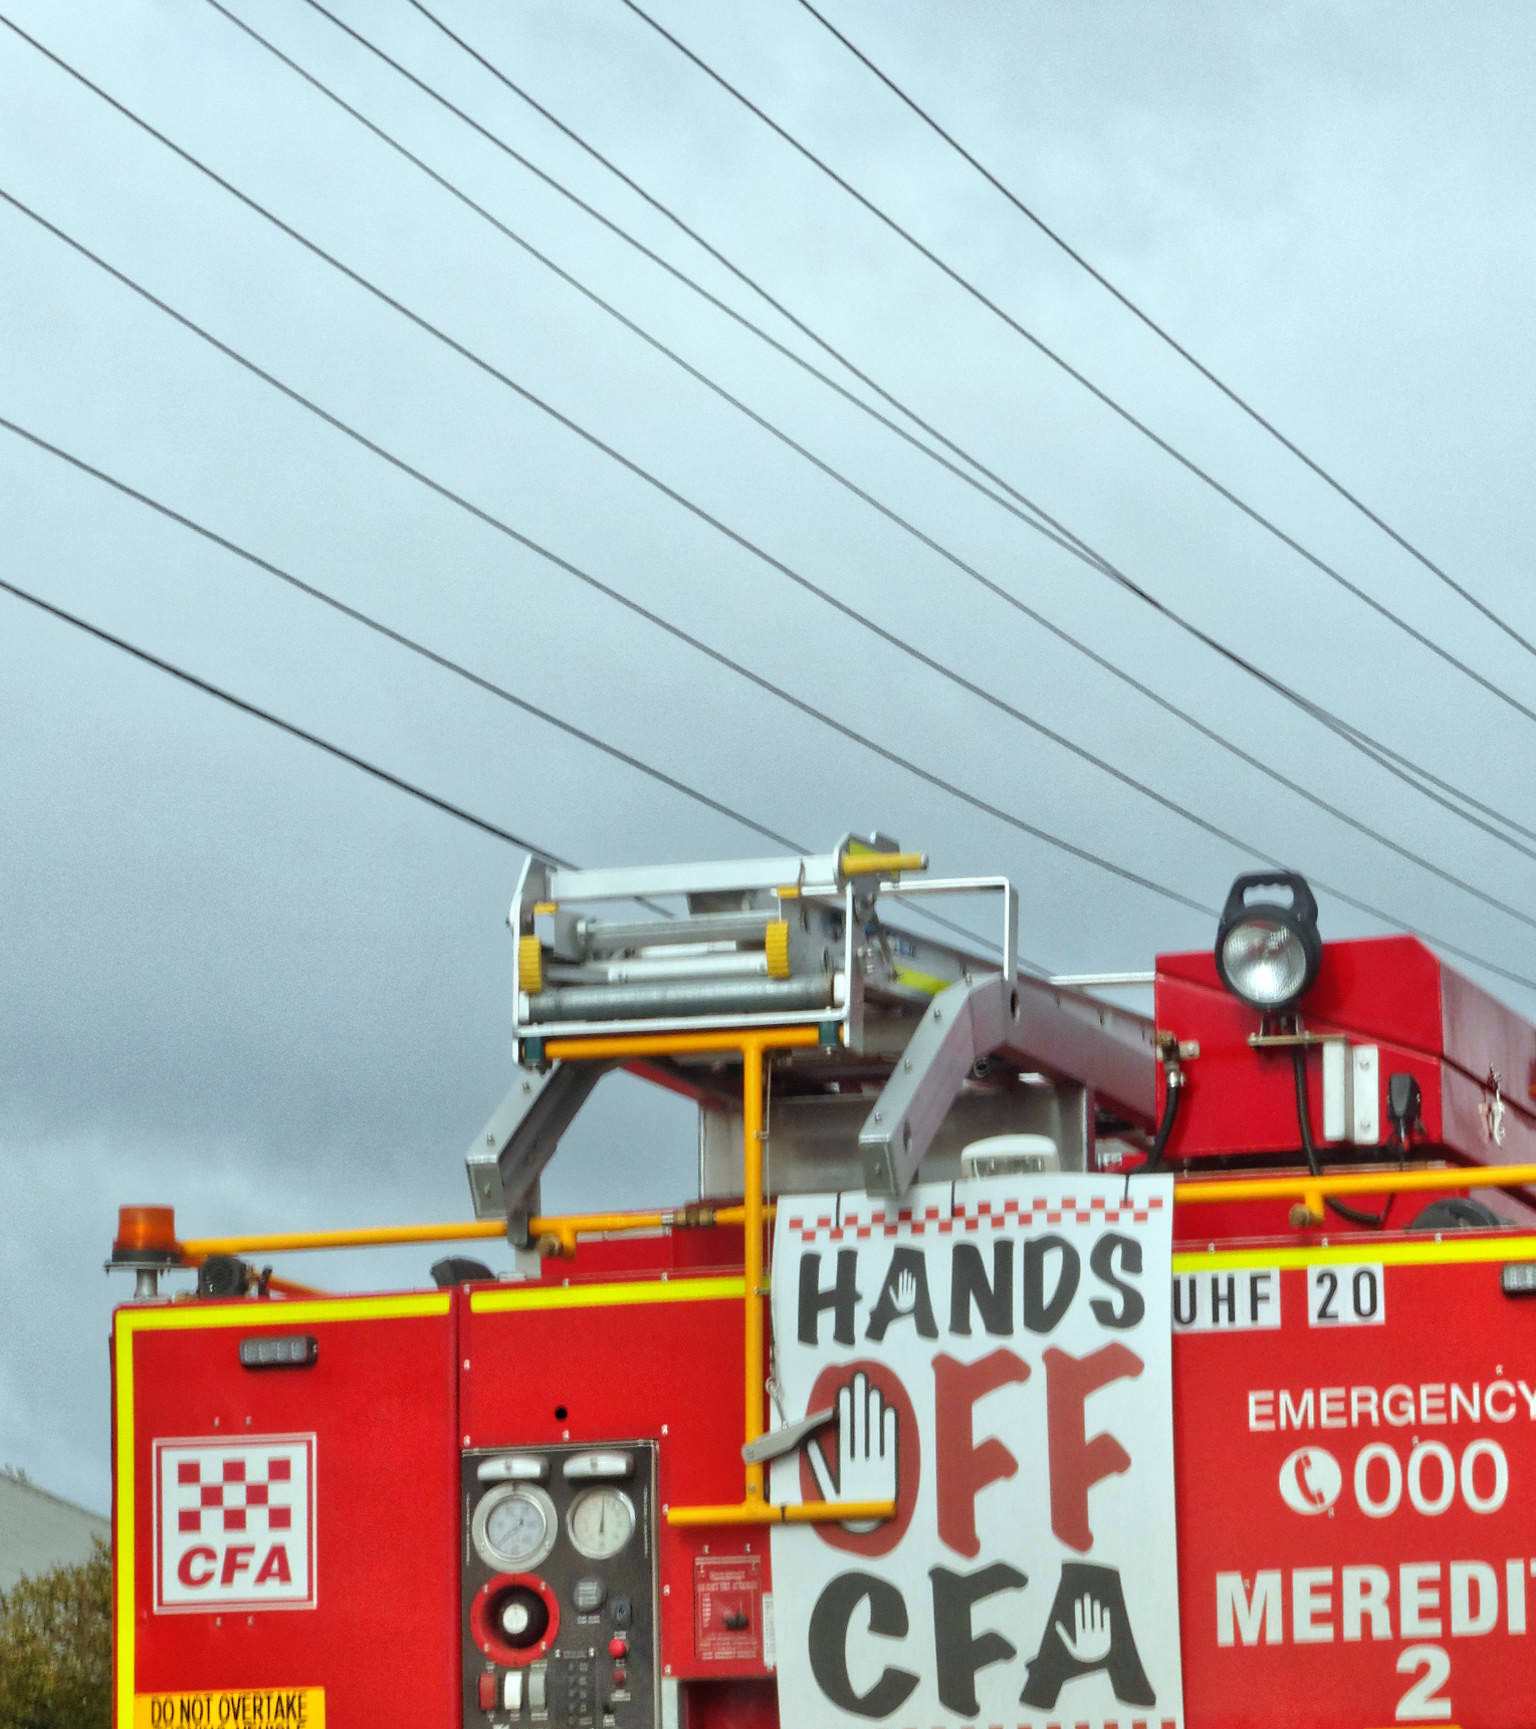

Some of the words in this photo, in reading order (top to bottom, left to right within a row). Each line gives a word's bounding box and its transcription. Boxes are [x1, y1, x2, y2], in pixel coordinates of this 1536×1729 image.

[797, 1230, 1145, 1346] HANDS
[1174, 1270, 1272, 1326] UHF
[1317, 1267, 1378, 1322] 20
[804, 1341, 1146, 1559] OFF
[1353, 1437, 1510, 1517] 000
[176, 1543, 293, 1587] CFA
[808, 1561, 1156, 1718] CFA
[151, 1695, 175, 1726] DO
[180, 1694, 212, 1723] NOT
[218, 1691, 308, 1722] OVERTAKE
[1394, 1645, 1453, 1720] 2
